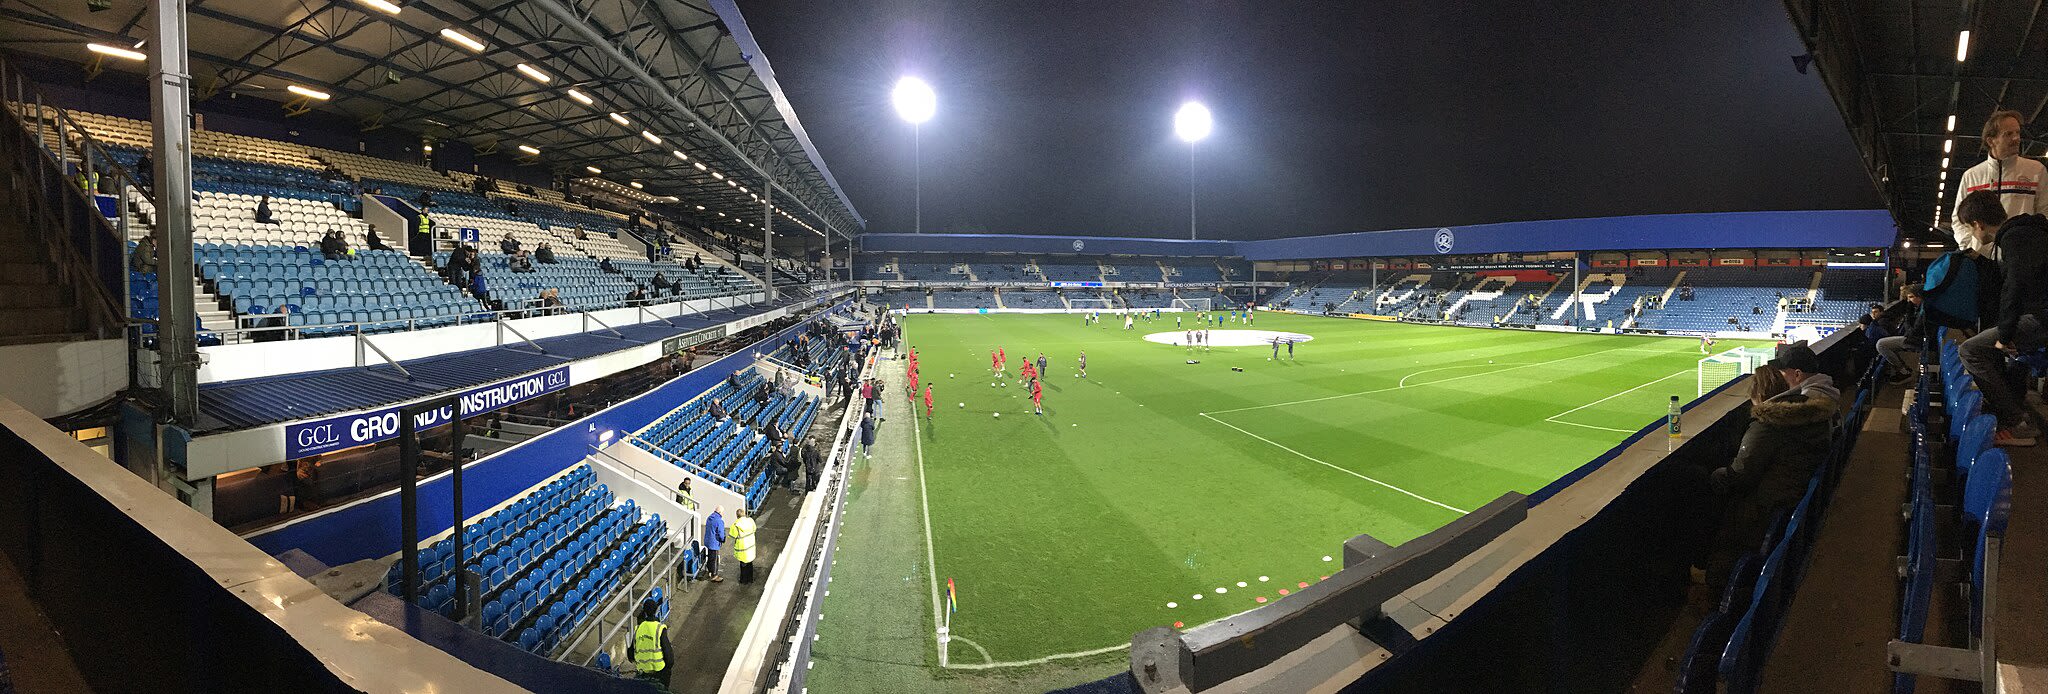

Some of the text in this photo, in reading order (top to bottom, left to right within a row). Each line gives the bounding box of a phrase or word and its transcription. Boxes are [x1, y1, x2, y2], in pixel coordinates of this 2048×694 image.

[466, 229, 474, 241] B
[298, 424, 339, 447] GCL
[350, 408, 438, 442] GROND
[548, 370, 566, 386] GCL
